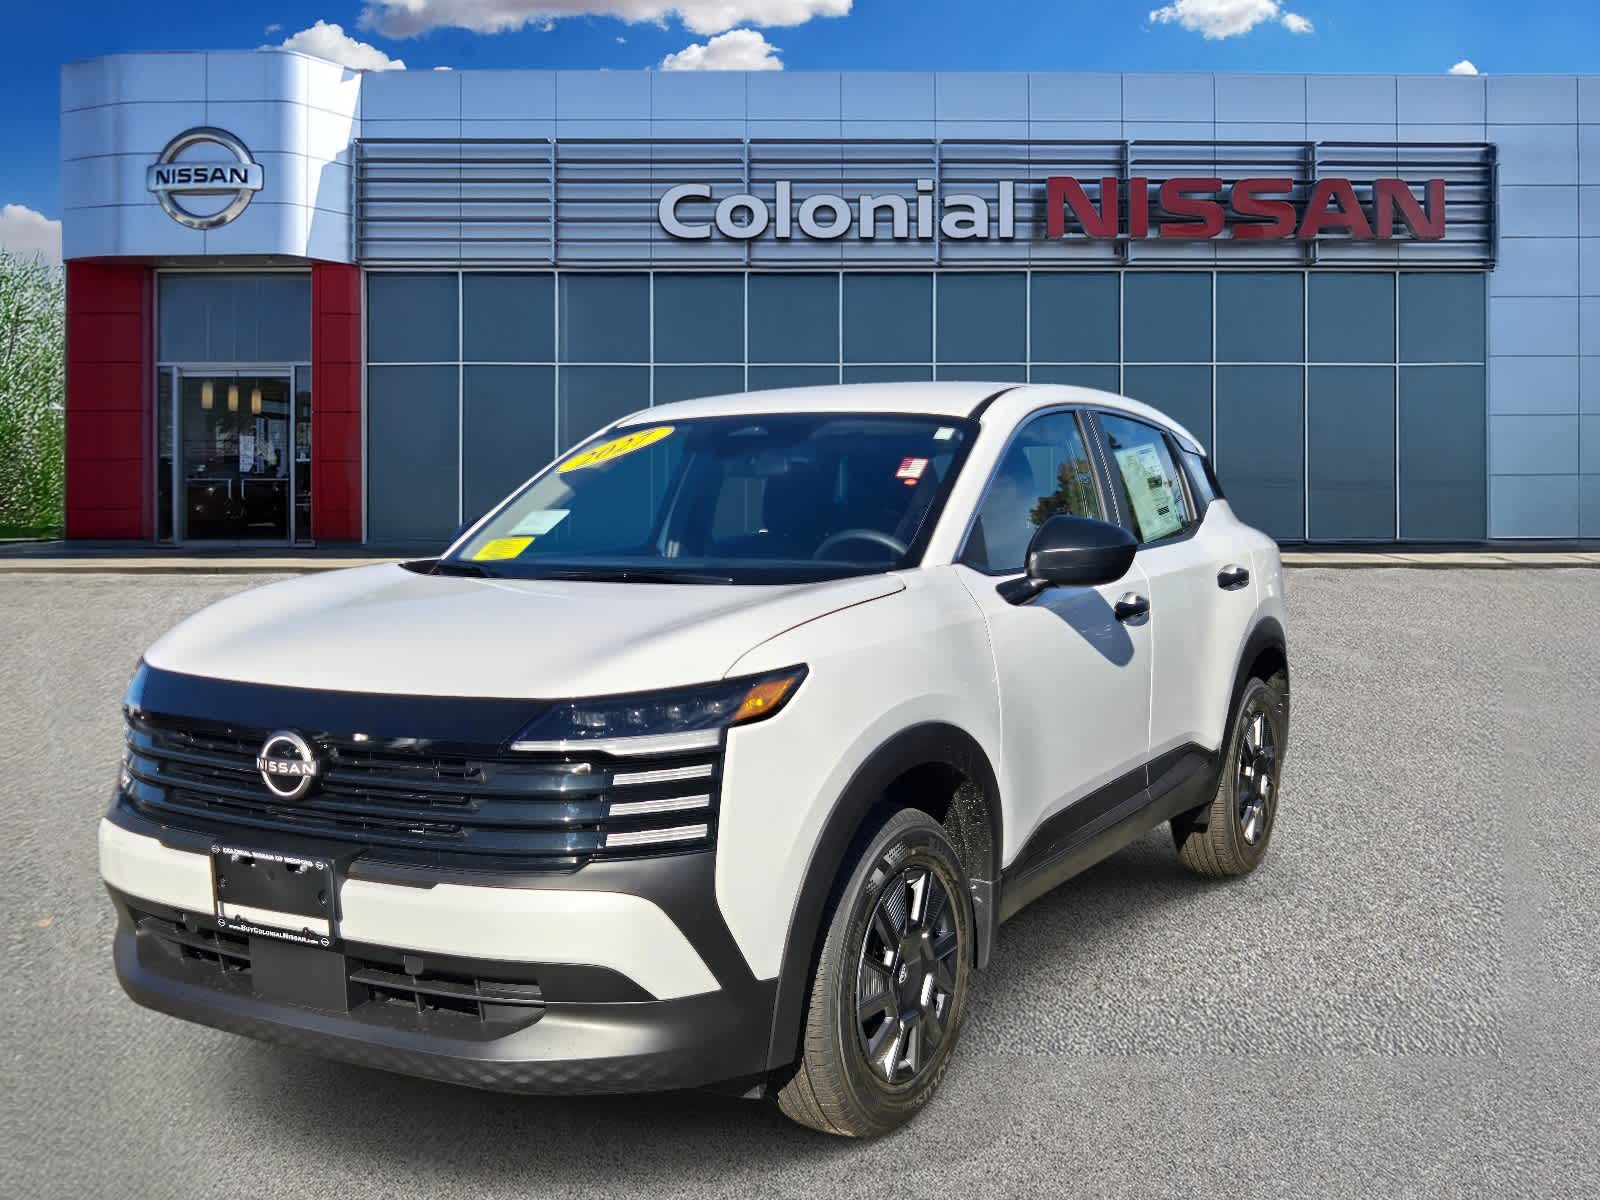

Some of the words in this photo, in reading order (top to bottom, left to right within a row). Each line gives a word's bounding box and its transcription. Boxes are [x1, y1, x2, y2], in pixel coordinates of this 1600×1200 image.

[155, 167, 249, 185] NISSAN
[657, 178, 1015, 240] Colonial
[1045, 176, 1446, 241] NISSAN
[256, 757, 317, 776] NISSAN
